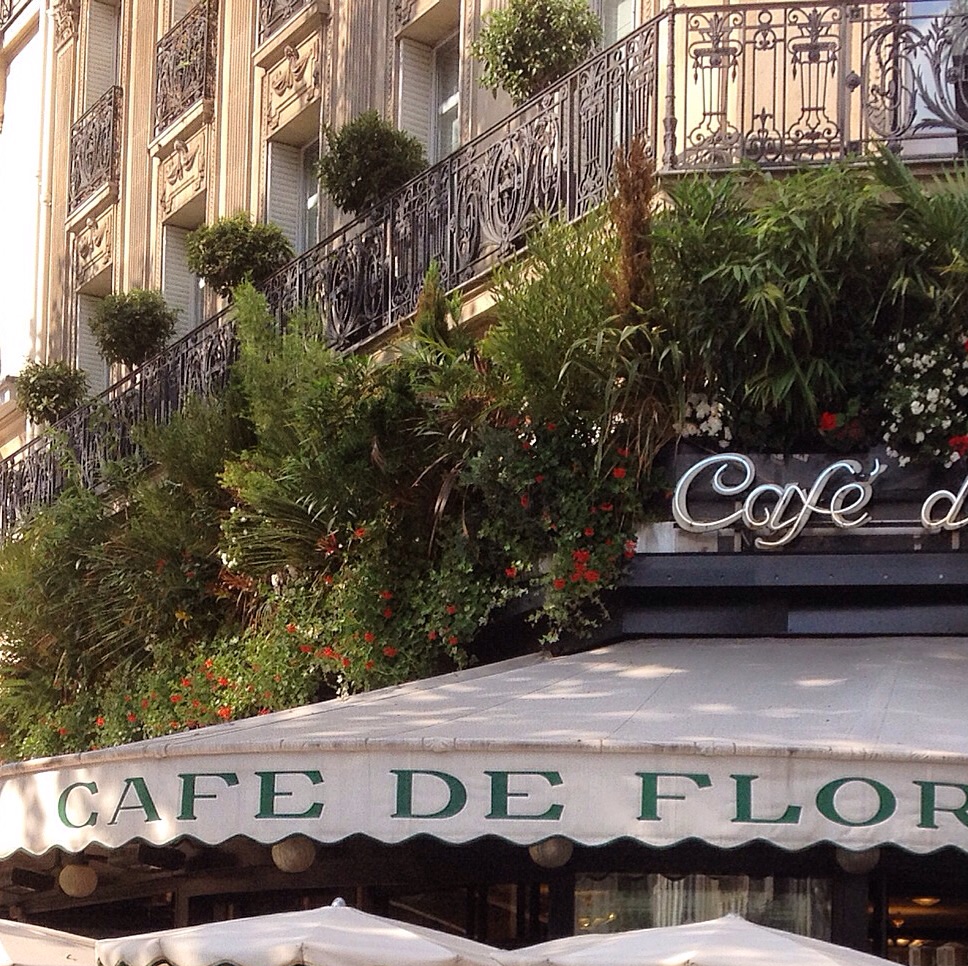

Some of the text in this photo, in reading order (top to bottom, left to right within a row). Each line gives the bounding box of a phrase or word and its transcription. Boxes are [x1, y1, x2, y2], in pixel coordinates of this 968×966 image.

[672, 453, 886, 549] Café
[57, 769, 324, 830] CAFE
[389, 769, 565, 821] DE
